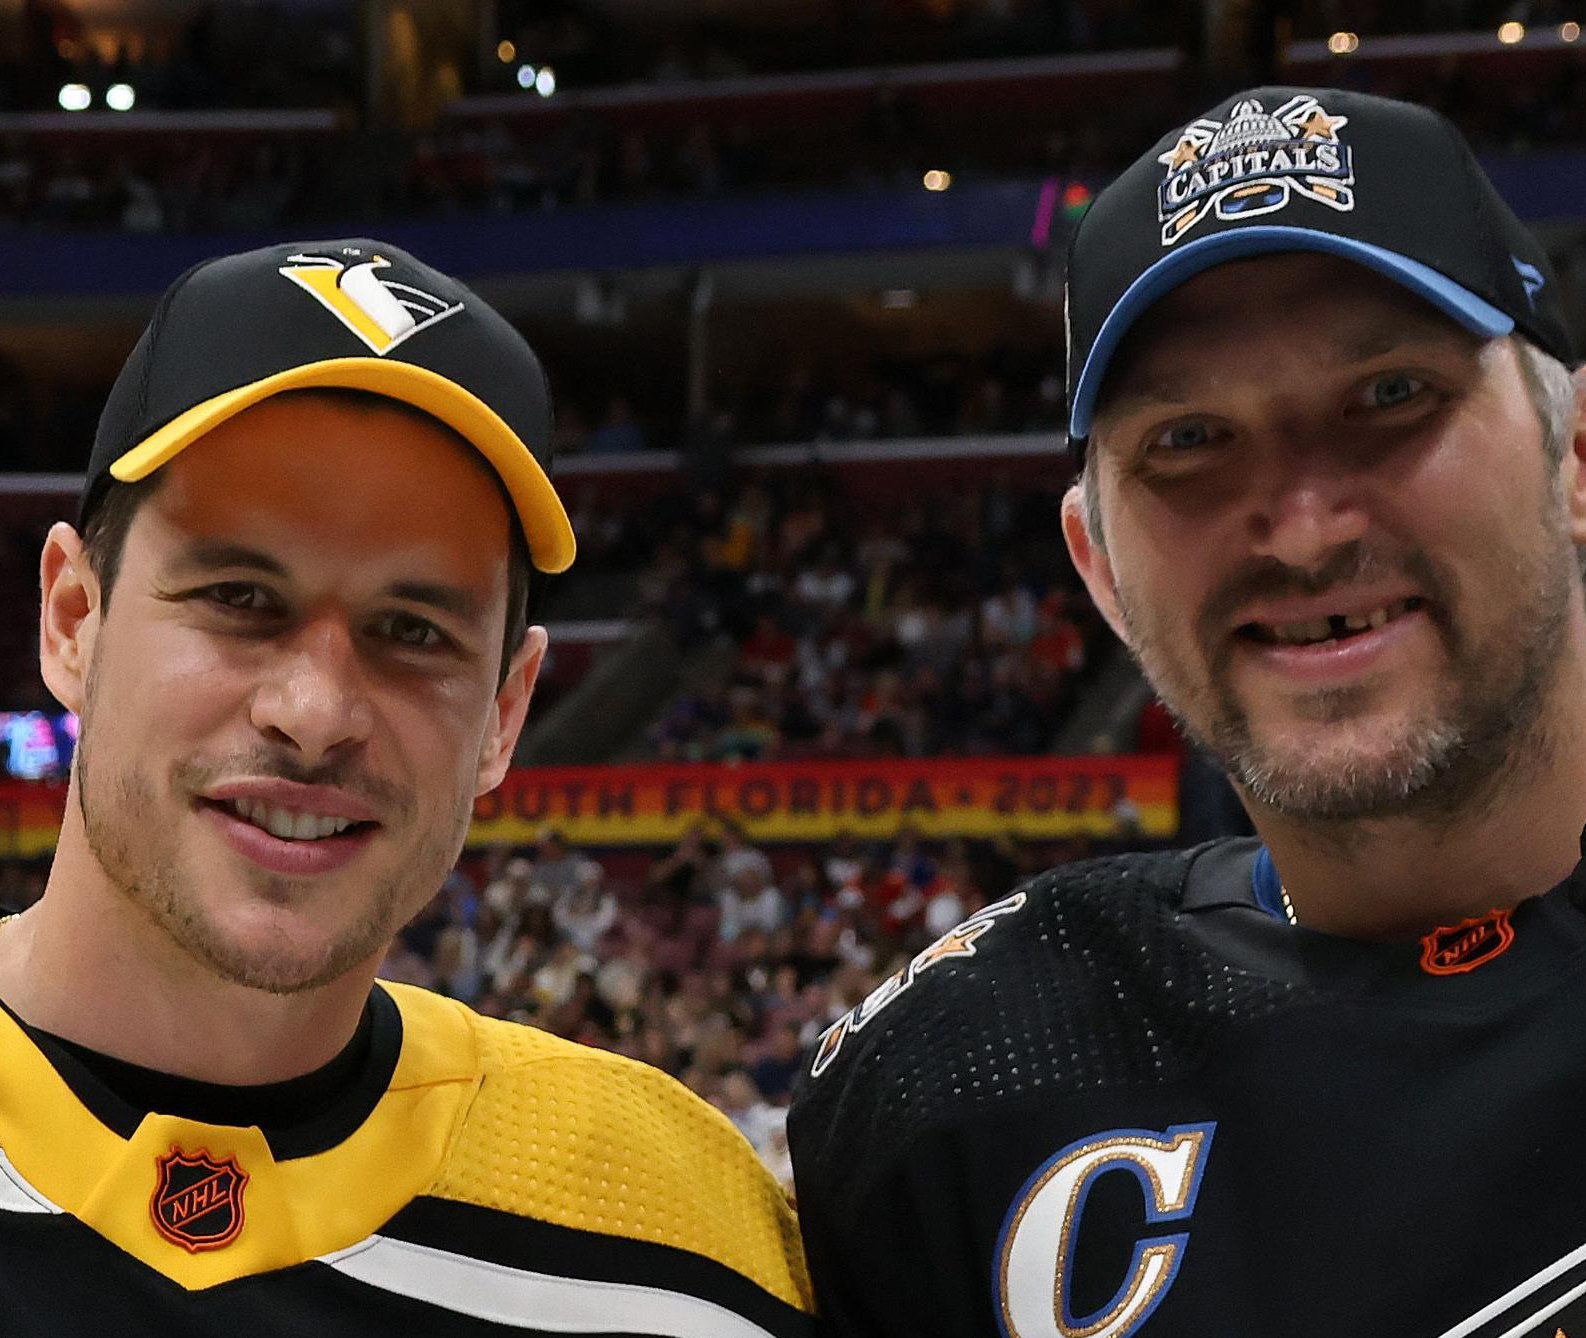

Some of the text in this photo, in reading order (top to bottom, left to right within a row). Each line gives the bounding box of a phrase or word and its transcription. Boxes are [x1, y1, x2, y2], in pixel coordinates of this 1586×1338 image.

[1166, 143, 1342, 204] CAPITALS
[474, 780, 636, 822] OUTH
[666, 775, 938, 821] FLORIDA
[171, 1179, 228, 1223] NHL
